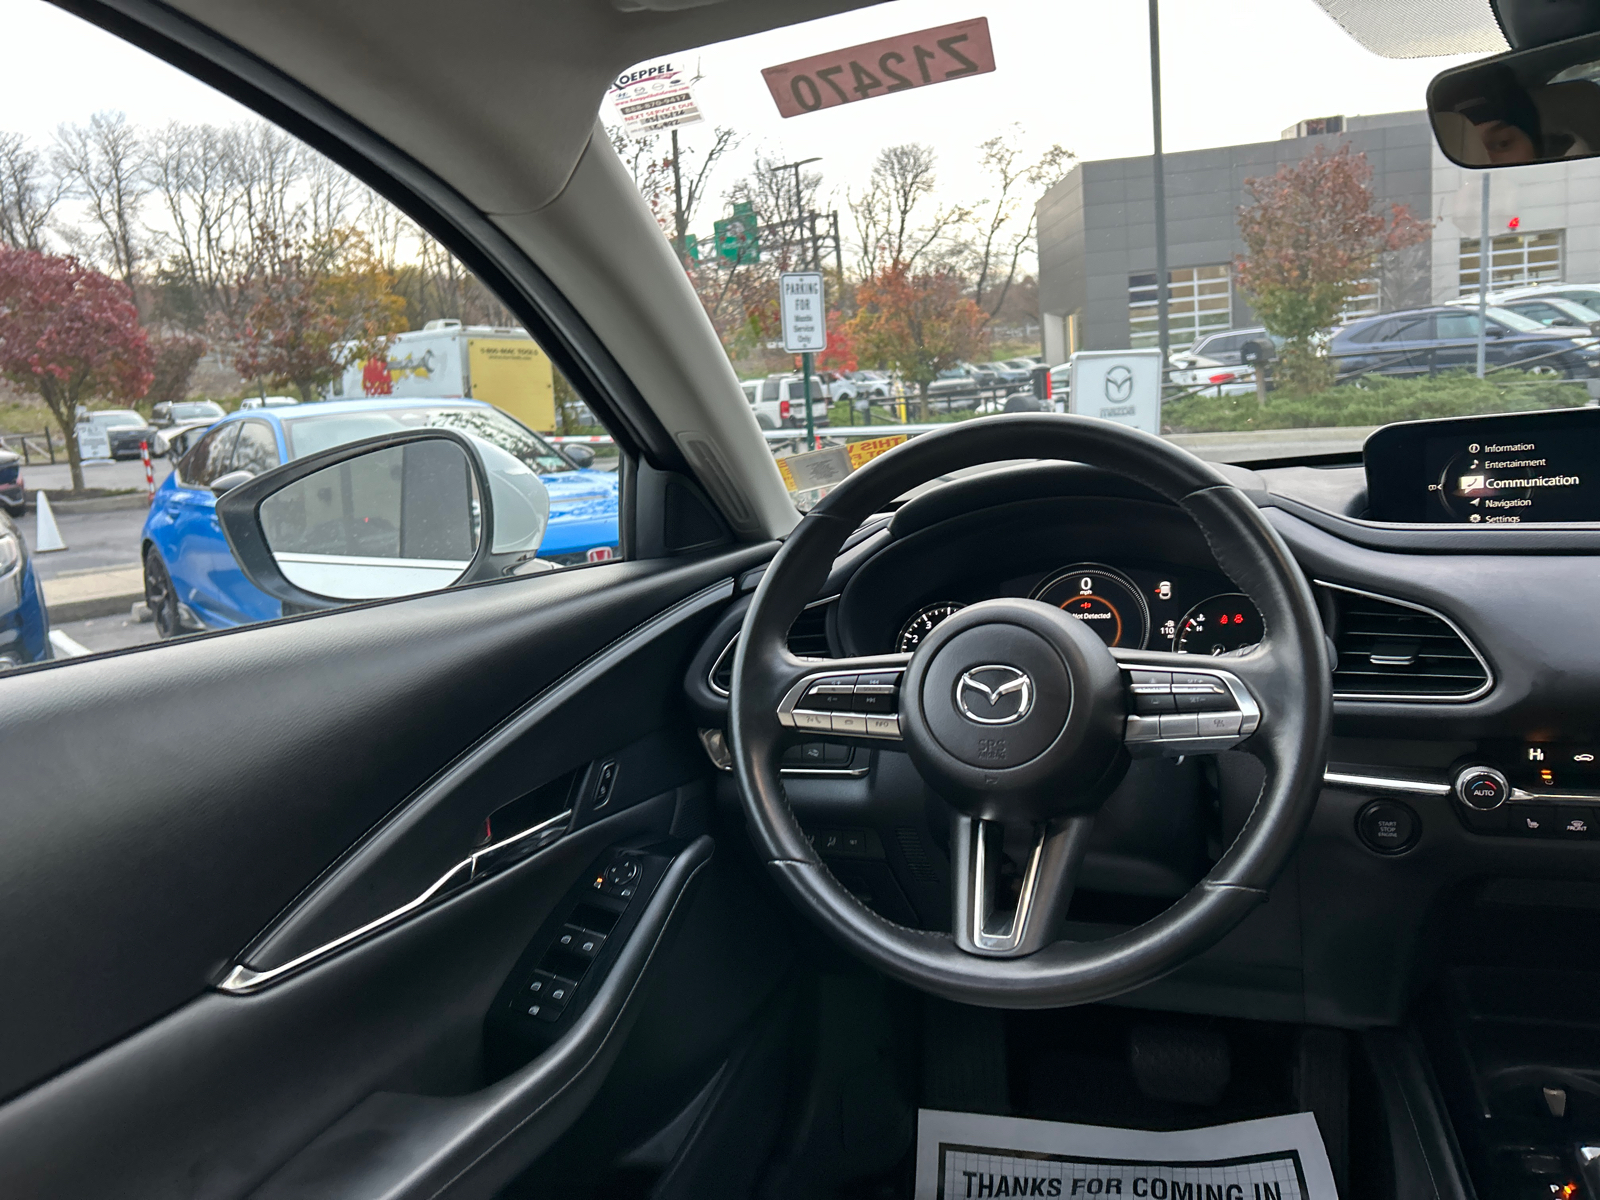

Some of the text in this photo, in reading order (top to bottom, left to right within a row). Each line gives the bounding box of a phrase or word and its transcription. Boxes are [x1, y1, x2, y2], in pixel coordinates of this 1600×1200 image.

[624, 101, 695, 122] NEXT SERVICE DUE
[785, 282, 819, 295] PARKING
[794, 298, 811, 311] FOR
[793, 324, 815, 333] Service
[797, 334, 812, 344] Only
[1484, 443, 1535, 453] Information
[1485, 458, 1546, 469] Entertainment
[1485, 475, 1579, 488] Communication
[1485, 498, 1532, 509] Navigation
[1485, 514, 1520, 523] Settings
[1080, 576, 1092, 590] 0
[1085, 612, 1111, 620] Detected
[925, 621, 932, 629] 3
[1160, 627, 1175, 635] 110
[912, 634, 919, 643] 2
[1473, 789, 1495, 797] AUTO
[962, 1171, 1282, 1200] THANKS FOR COMING IN
